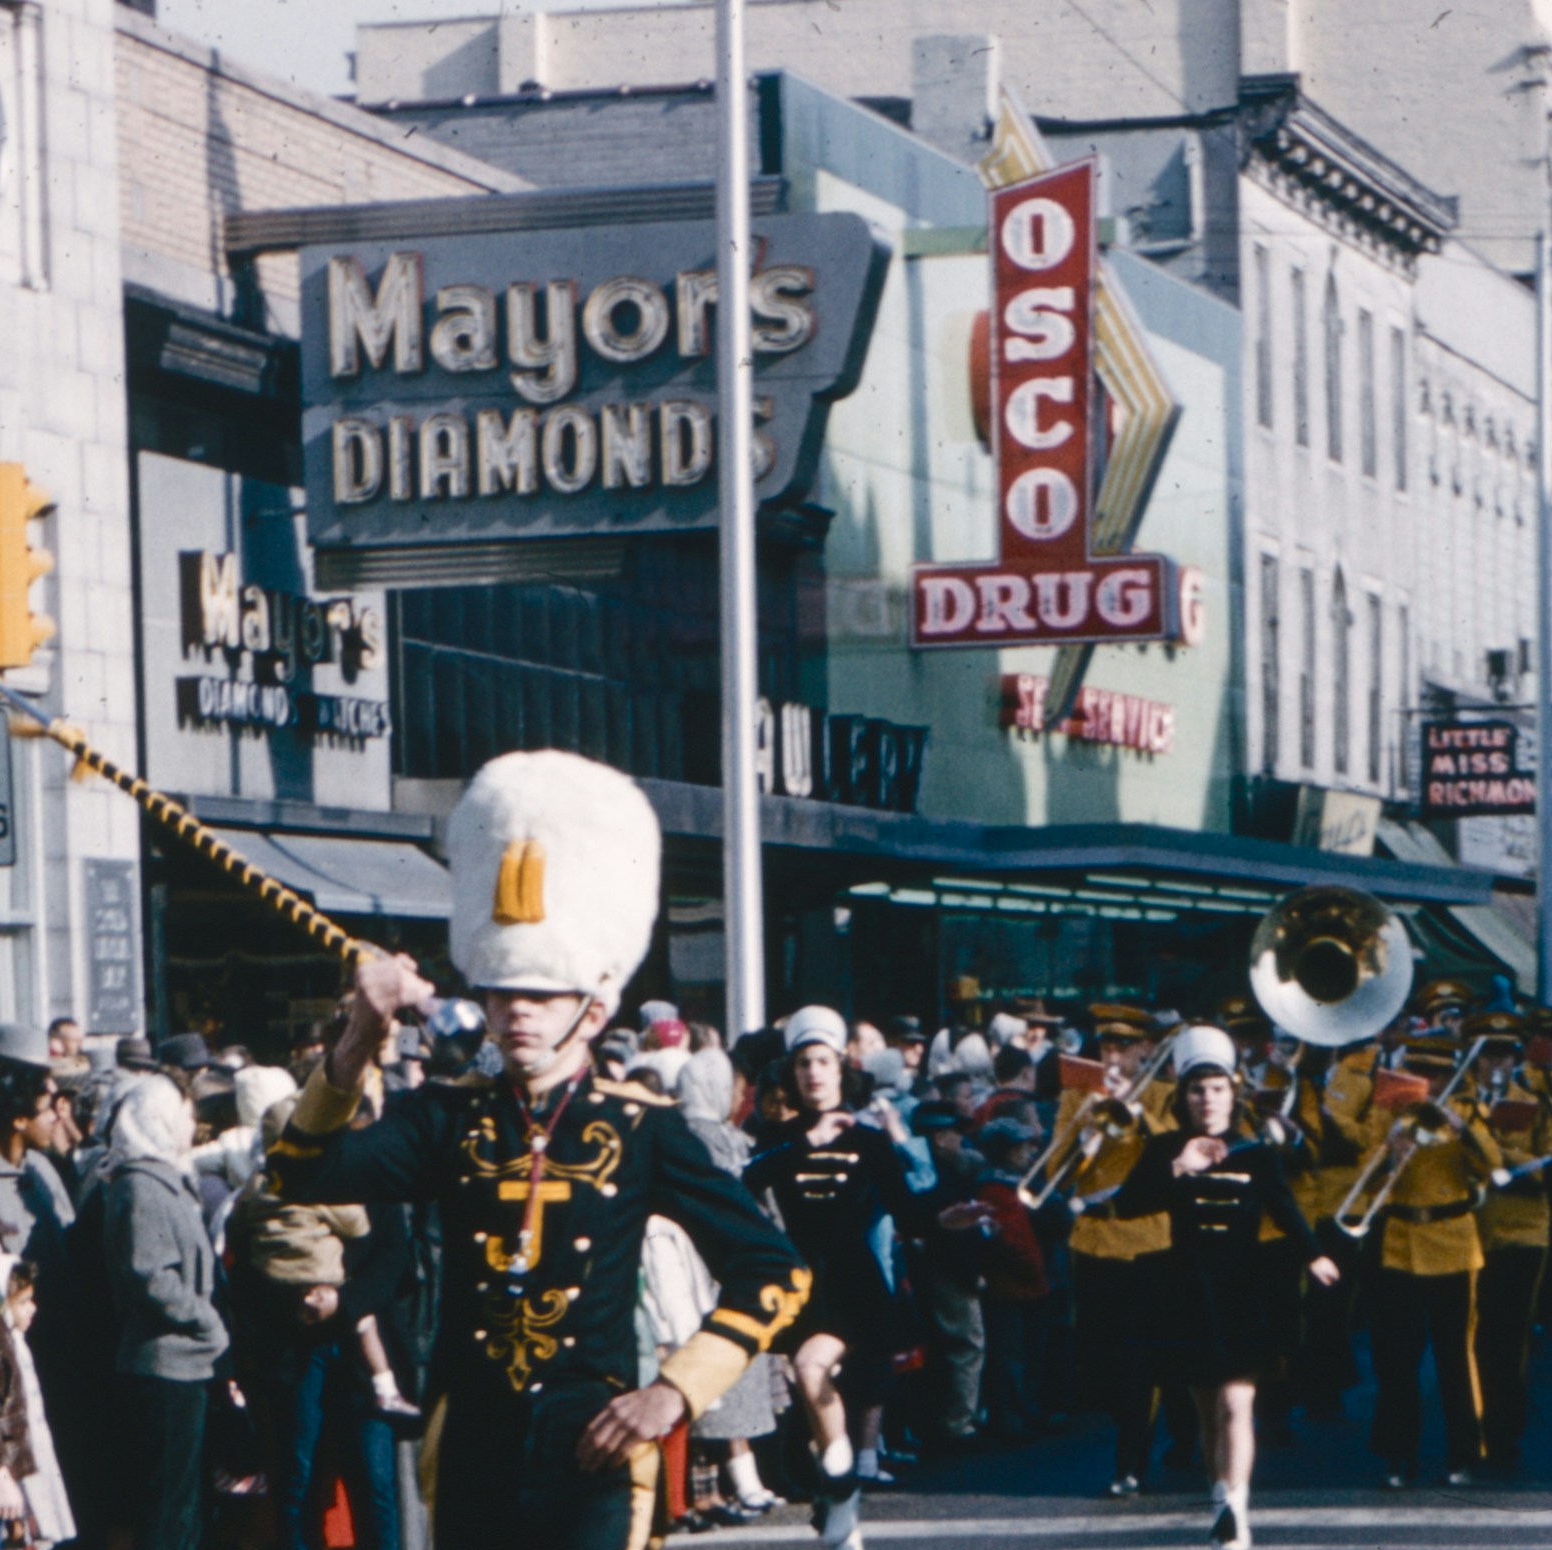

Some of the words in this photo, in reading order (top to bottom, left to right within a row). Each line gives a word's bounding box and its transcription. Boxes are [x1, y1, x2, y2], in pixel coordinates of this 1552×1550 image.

[328, 235, 818, 404] Mayor's
[1000, 197, 1078, 541] OSCO
[201, 552, 385, 684] Mayor's
[919, 569, 1152, 635] DRUG
[1429, 726, 1509, 749] LITTLE
[1430, 753, 1510, 775] MISS
[486, 1181, 571, 1272] J
